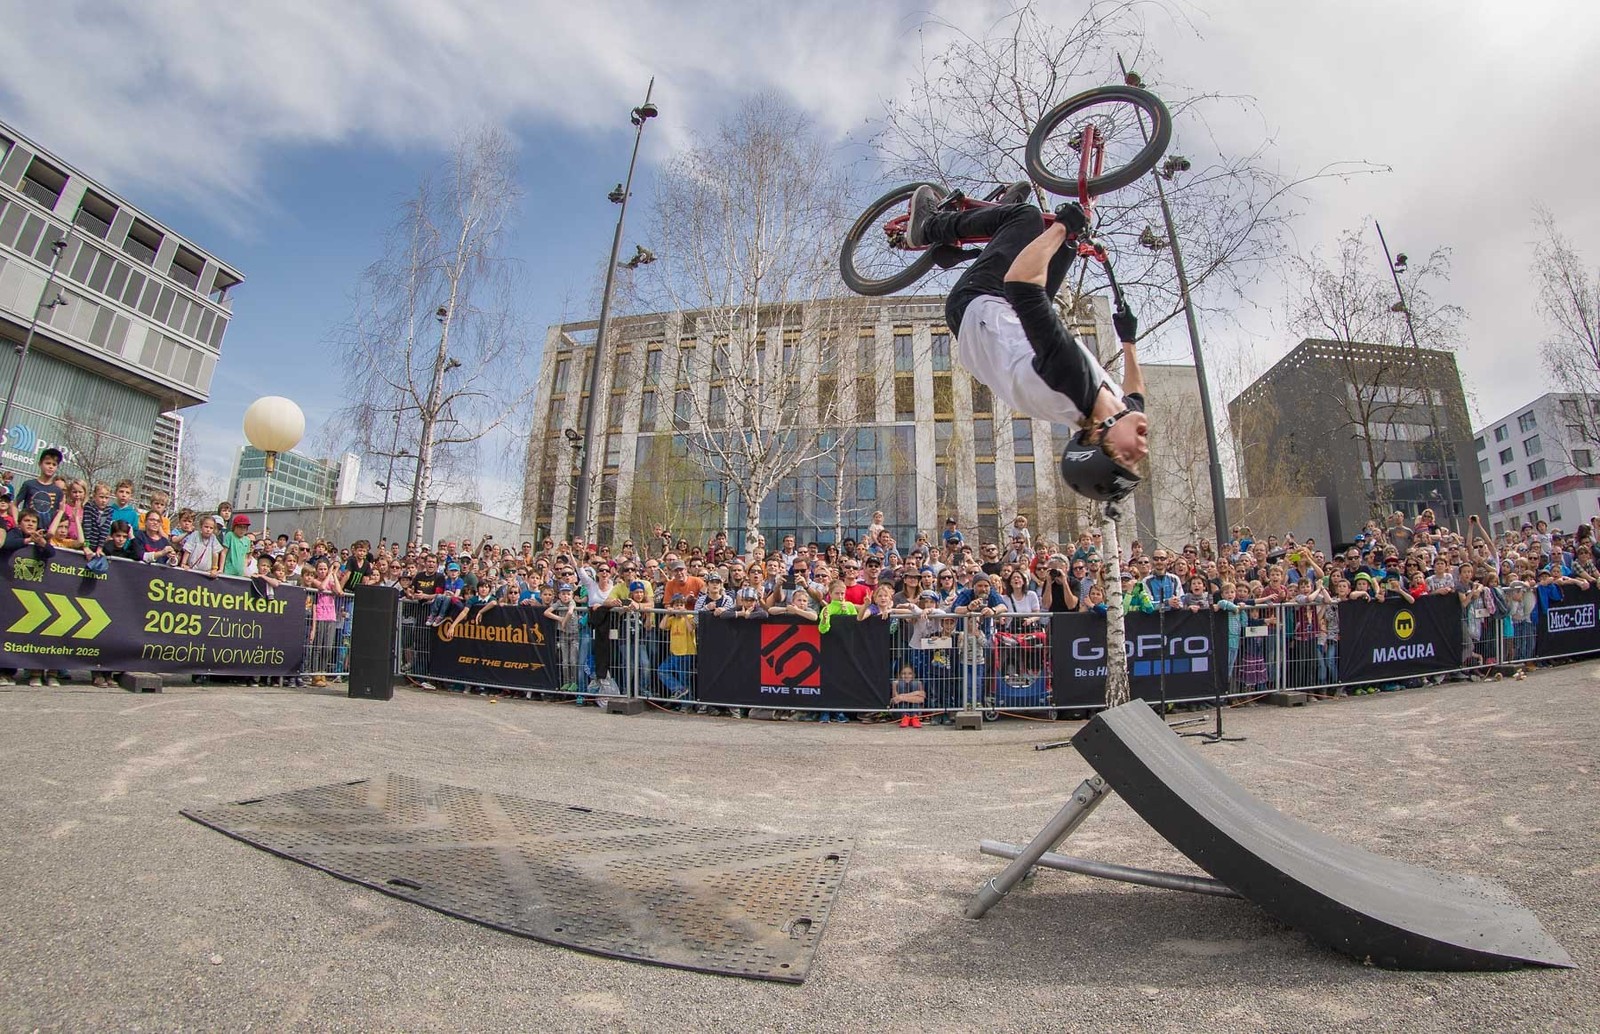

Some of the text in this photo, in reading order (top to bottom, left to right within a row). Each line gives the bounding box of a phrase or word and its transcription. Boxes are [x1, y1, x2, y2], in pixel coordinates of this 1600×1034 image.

[1, 450, 35, 465] MIGROS
[50, 562, 76, 576] Stadt
[147, 578, 288, 615] Stadtverkehr
[144, 609, 263, 640] 2025 Zürich
[1550, 606, 1594, 629] Muc-Off
[437, 616, 530, 644] Cntinental
[3, 641, 100, 657] Stadtverkehr 2025
[141, 641, 285, 666] macht vorwärts
[1372, 642, 1435, 663] MAGURA
[458, 656, 530, 670] GET THE GRIP
[1074, 668, 1088, 677] Be
[760, 686, 821, 695] FIVE TEN
